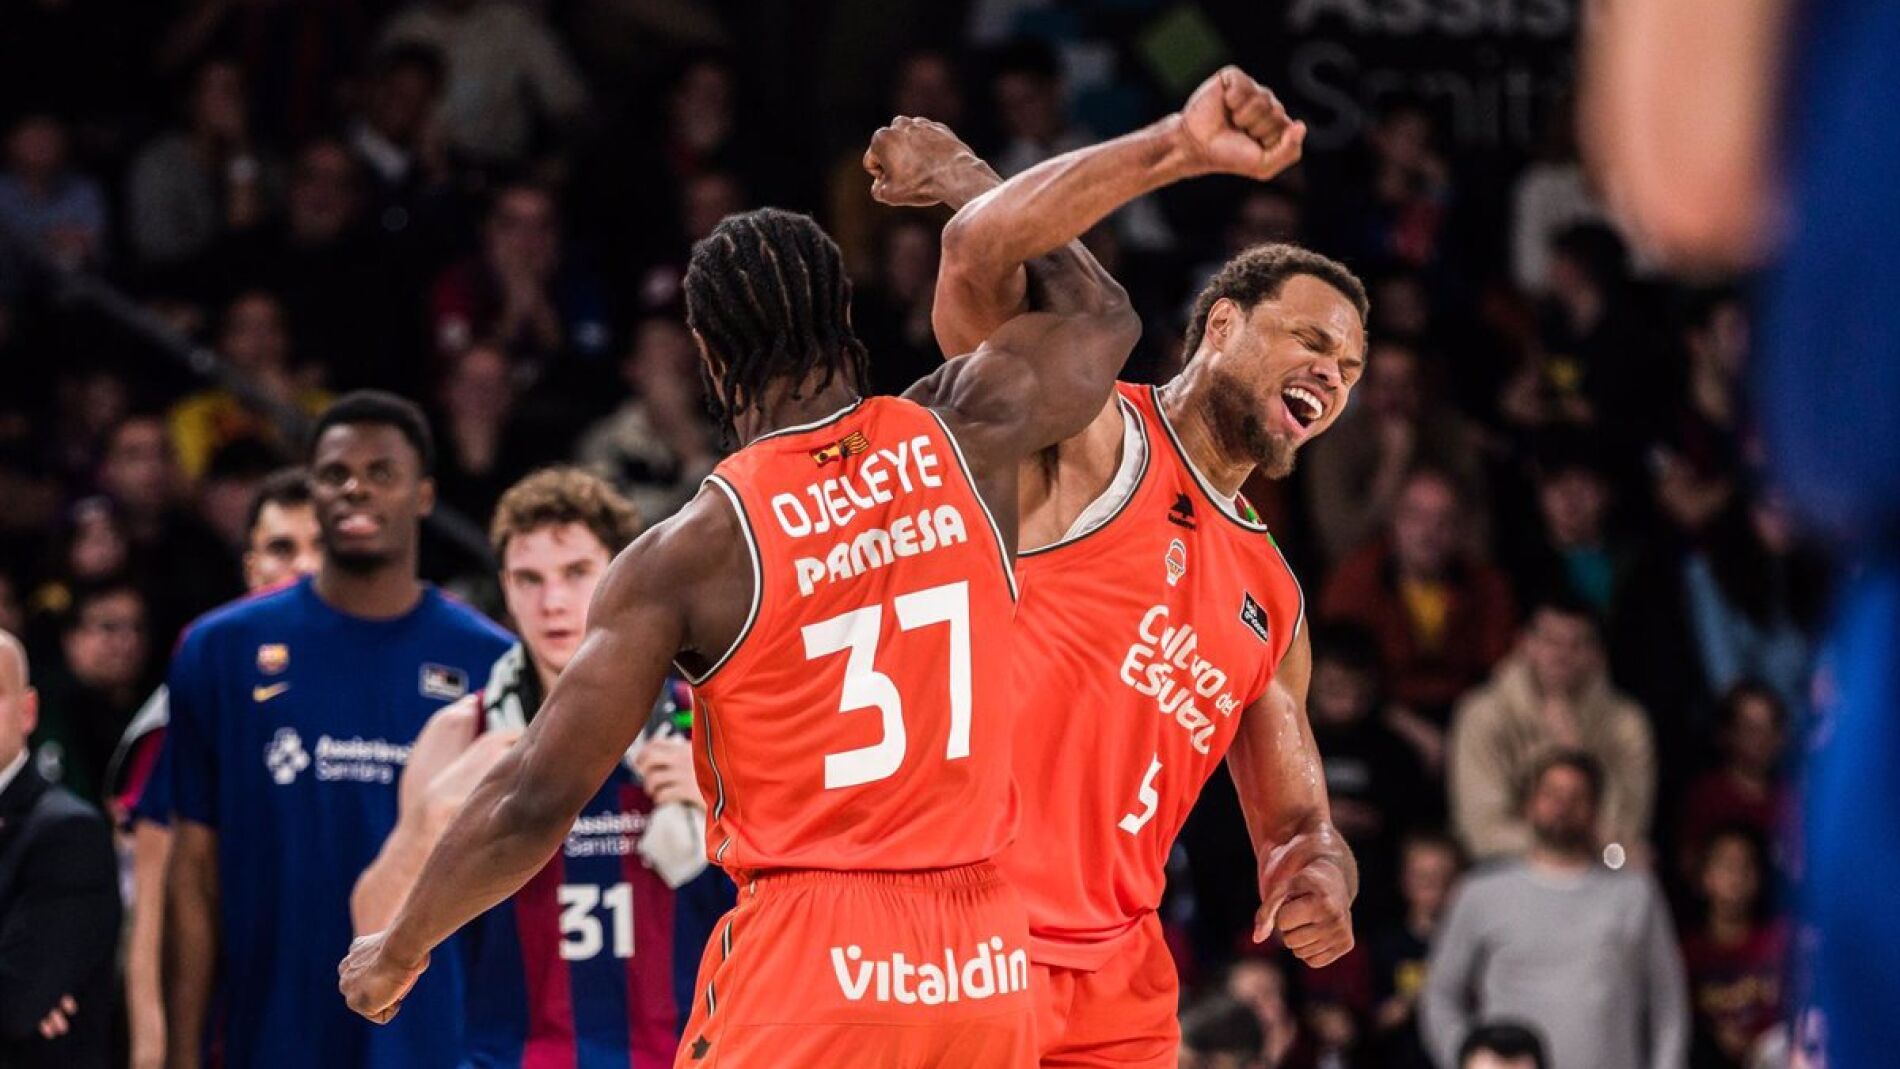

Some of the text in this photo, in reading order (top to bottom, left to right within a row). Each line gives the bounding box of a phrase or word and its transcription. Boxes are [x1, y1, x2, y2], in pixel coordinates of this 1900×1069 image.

[771, 435, 942, 538] OJELEYE
[794, 504, 968, 597] PAMESA
[801, 580, 972, 790] 37
[1117, 752, 1163, 836] 5
[559, 883, 634, 961] 31
[830, 935, 1028, 1006] Vitaldin
